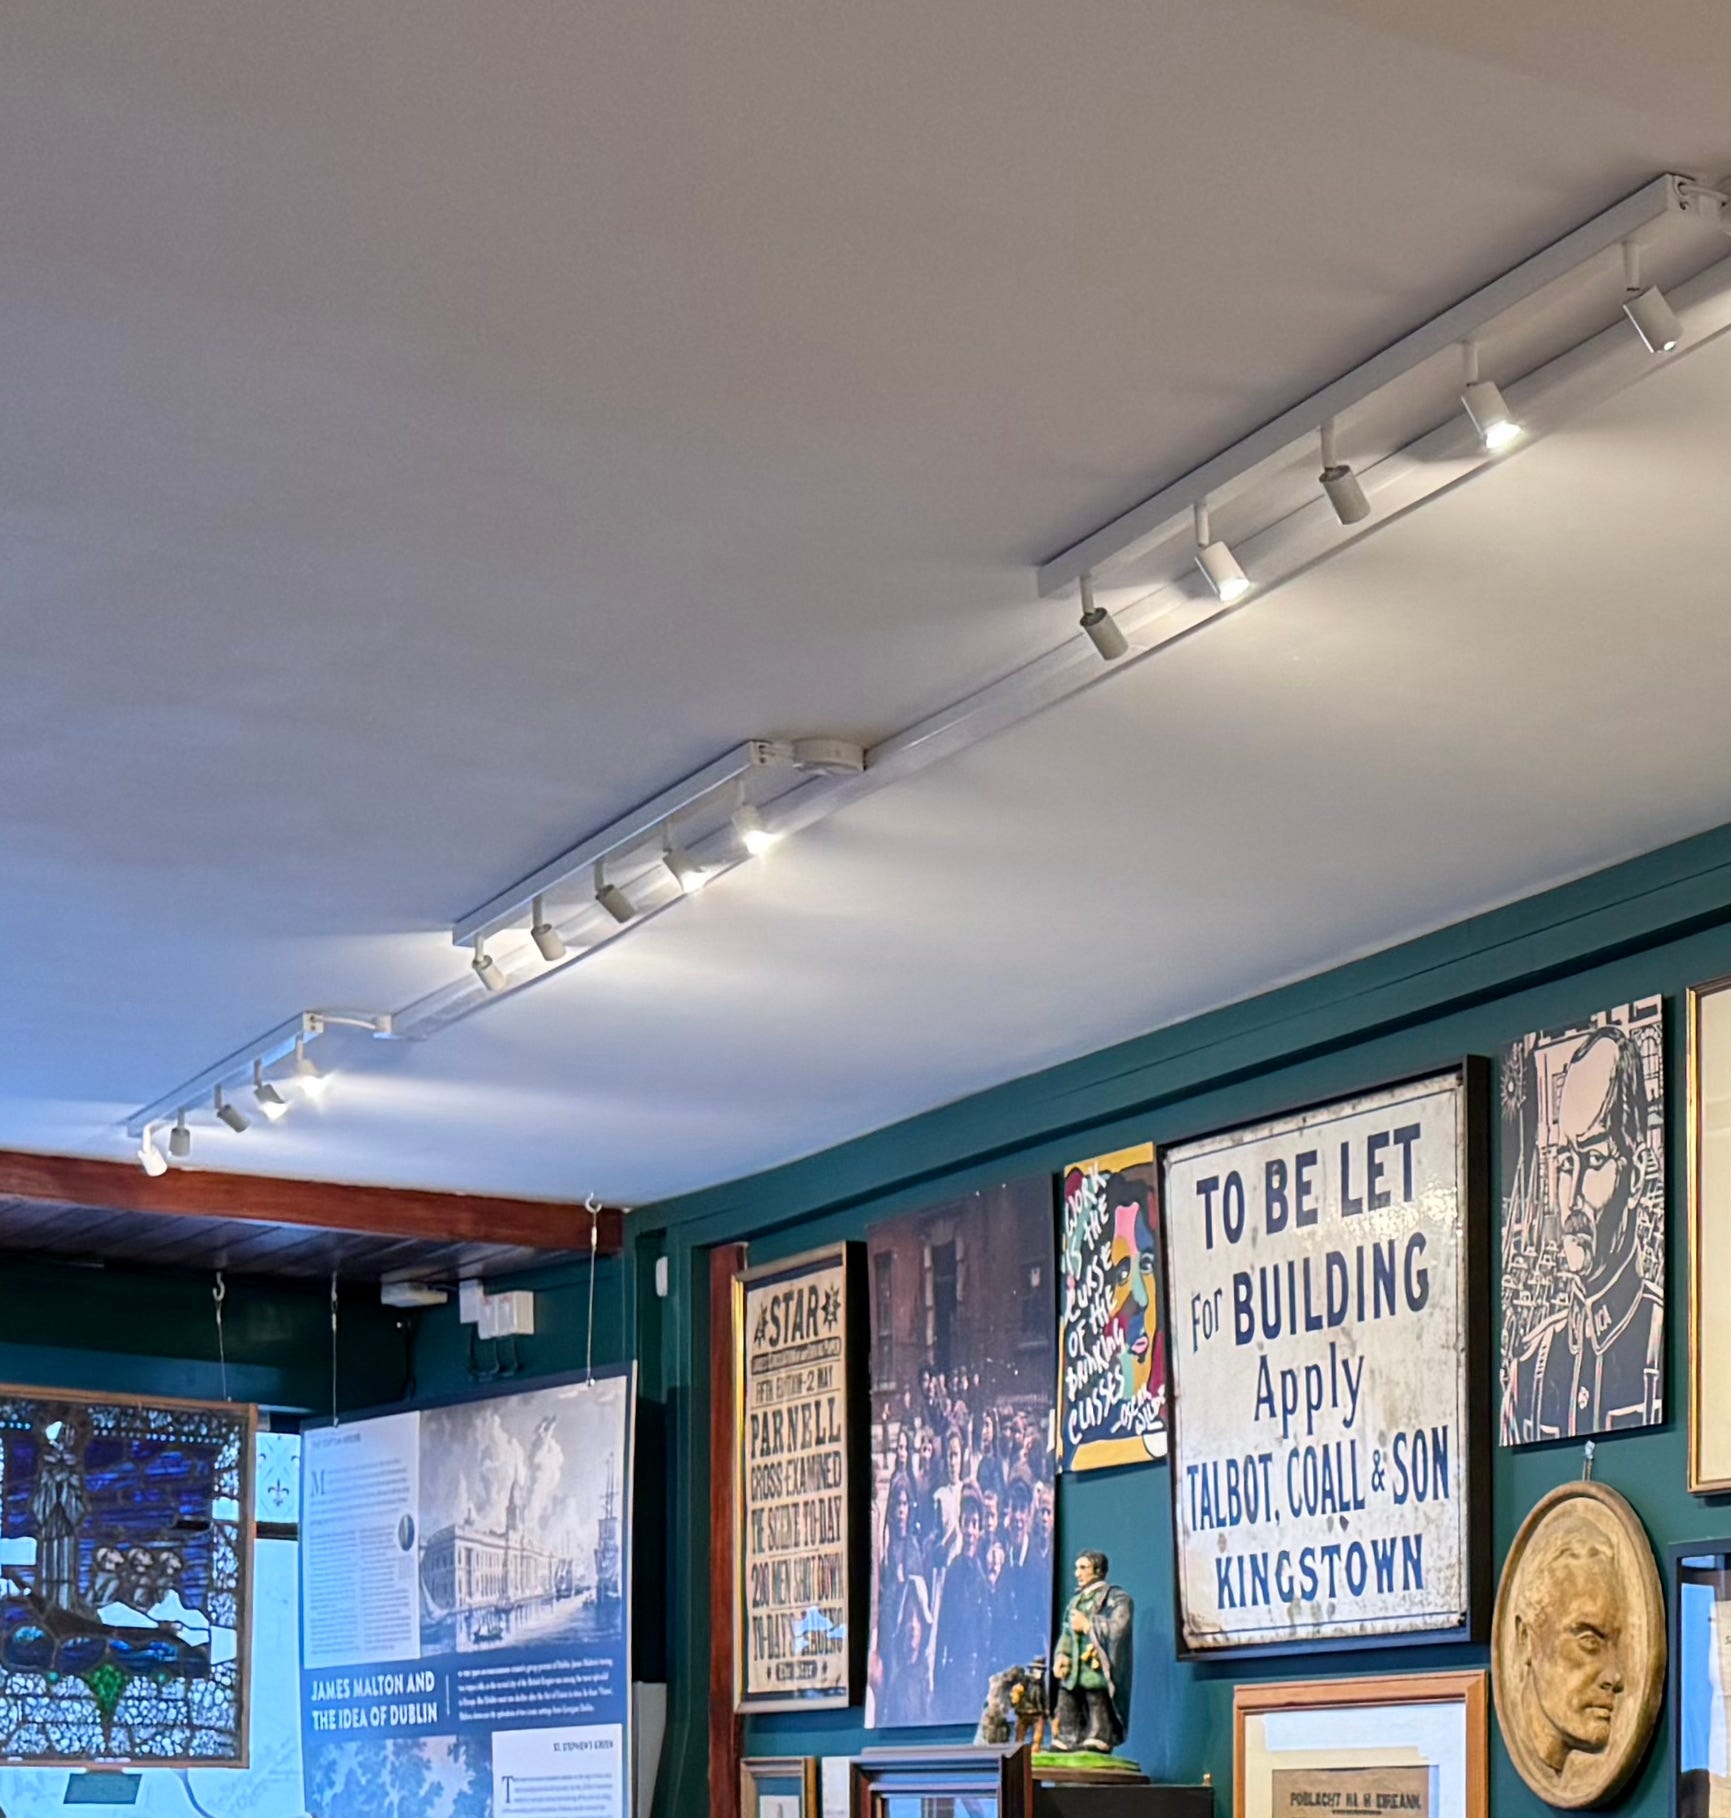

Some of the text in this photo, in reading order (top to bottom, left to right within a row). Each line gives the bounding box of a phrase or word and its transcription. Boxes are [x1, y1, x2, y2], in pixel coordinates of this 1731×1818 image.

[1065, 1163, 1107, 1238] WORK
[1084, 1194, 1109, 1250] THE
[1196, 1122, 1421, 1250] TO BE LET
[769, 1284, 819, 1347] STAR
[1069, 1286, 1117, 1358] OF THE
[1191, 1231, 1429, 1354] For BUILDING
[1254, 1341, 1365, 1439] Apply
[751, 1397, 841, 1460] PARNELL
[1187, 1424, 1450, 1532] TALBOT, COALL & SON
[1216, 1532, 1424, 1610] KINGSTOWN
[312, 1671, 435, 1702] JAMES MALTON AND
[312, 1702, 438, 1731] THE IDEA OF DUBLIN
